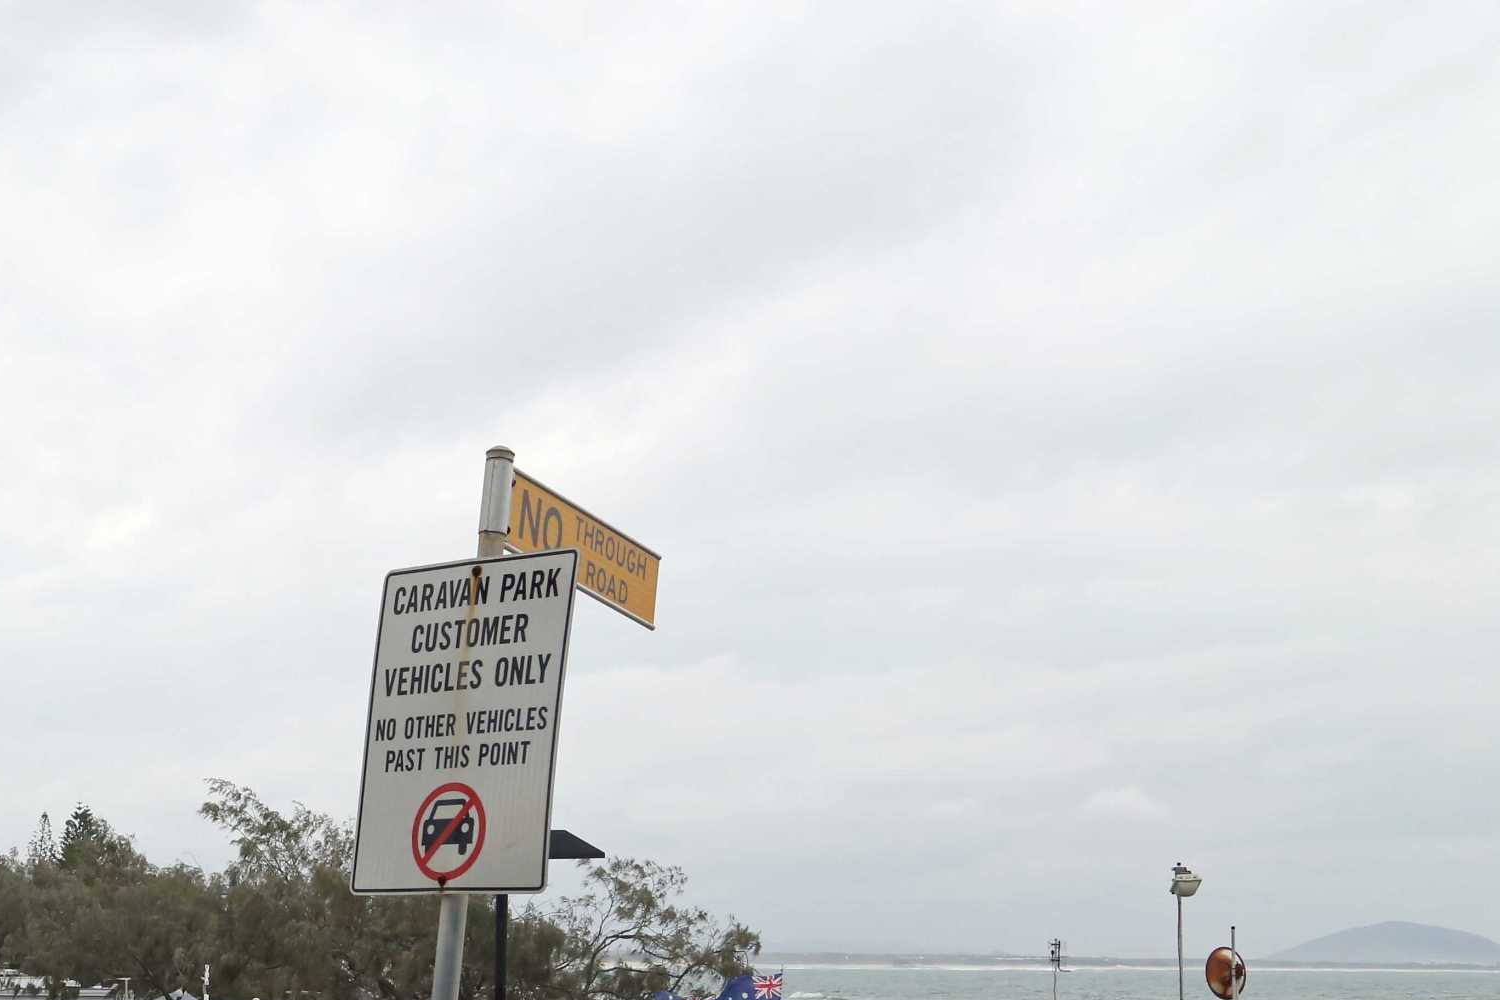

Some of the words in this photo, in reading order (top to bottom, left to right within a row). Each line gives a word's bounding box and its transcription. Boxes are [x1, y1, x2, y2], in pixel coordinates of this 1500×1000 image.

[518, 489, 563, 550] NO
[575, 516, 648, 580] THROUGH
[392, 575, 491, 616] CARAVAN
[499, 567, 562, 603] PARK
[585, 560, 628, 604] ROAD
[411, 613, 529, 654] CUSTOMER
[384, 659, 484, 697] VEHICLES
[494, 653, 552, 687] ONLY
[375, 718, 397, 742] NO
[404, 713, 457, 740] OTHER
[466, 706, 549, 735] VEHICLES
[385, 748, 426, 773] PAST
[435, 745, 470, 770] THIS
[478, 740, 531, 767] POINT
